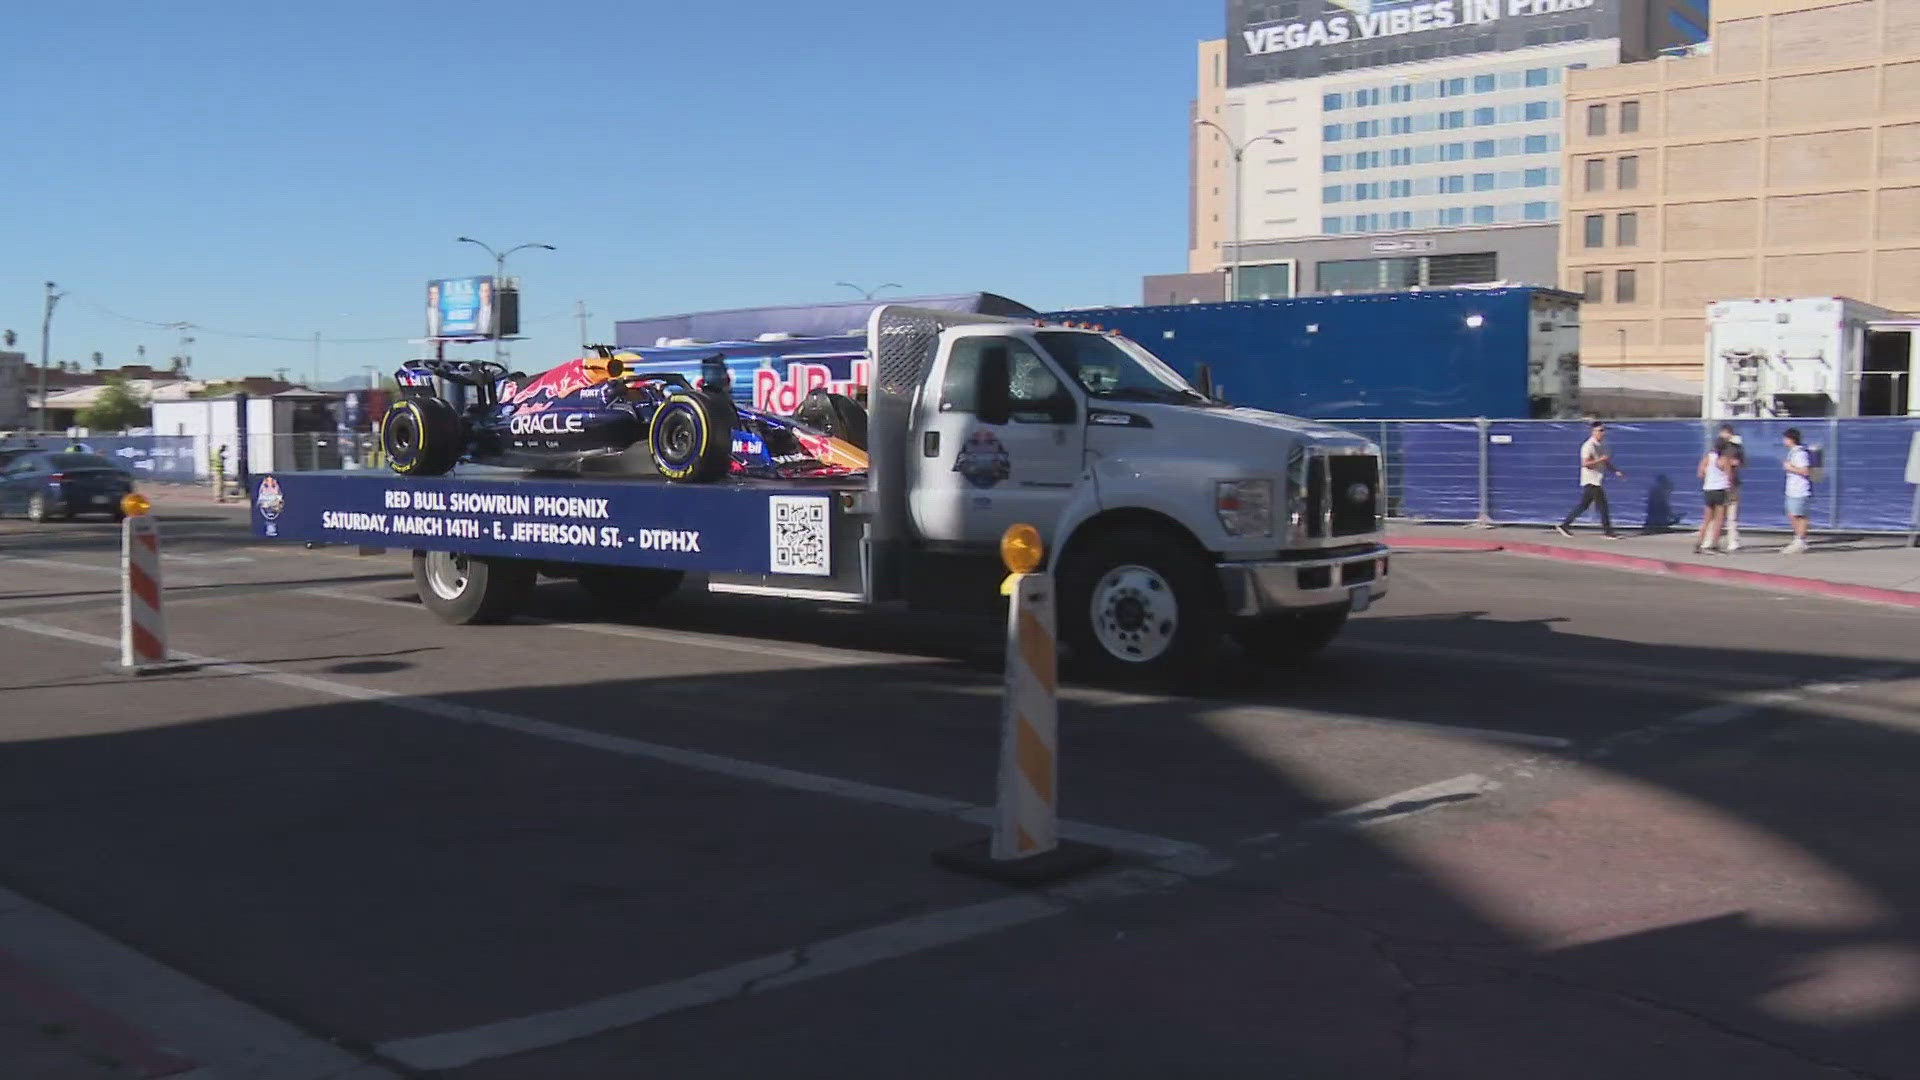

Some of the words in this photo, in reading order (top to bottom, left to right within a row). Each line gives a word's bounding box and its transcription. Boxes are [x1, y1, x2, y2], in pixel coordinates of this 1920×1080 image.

[1243, 16, 1351, 55] VEGAS
[1355, 1, 1455, 38] VIBES
[1462, 0, 1501, 25] IN
[754, 365, 799, 415] Rd
[510, 412, 585, 435] ORACLE
[731, 440, 763, 455] Mobil
[384, 490, 411, 509] RED
[413, 491, 446, 511] BULL
[449, 493, 530, 515] SHOWRUN
[533, 496, 609, 519] PHOENIX
[322, 510, 389, 535] SATURDAY,
[392, 515, 443, 537] MARCH
[445, 519, 480, 539] 14TH
[493, 521, 507, 540] E.
[510, 522, 596, 547] JEFFERSON
[599, 527, 623, 549] ST.
[639, 529, 701, 553] DTPHX
